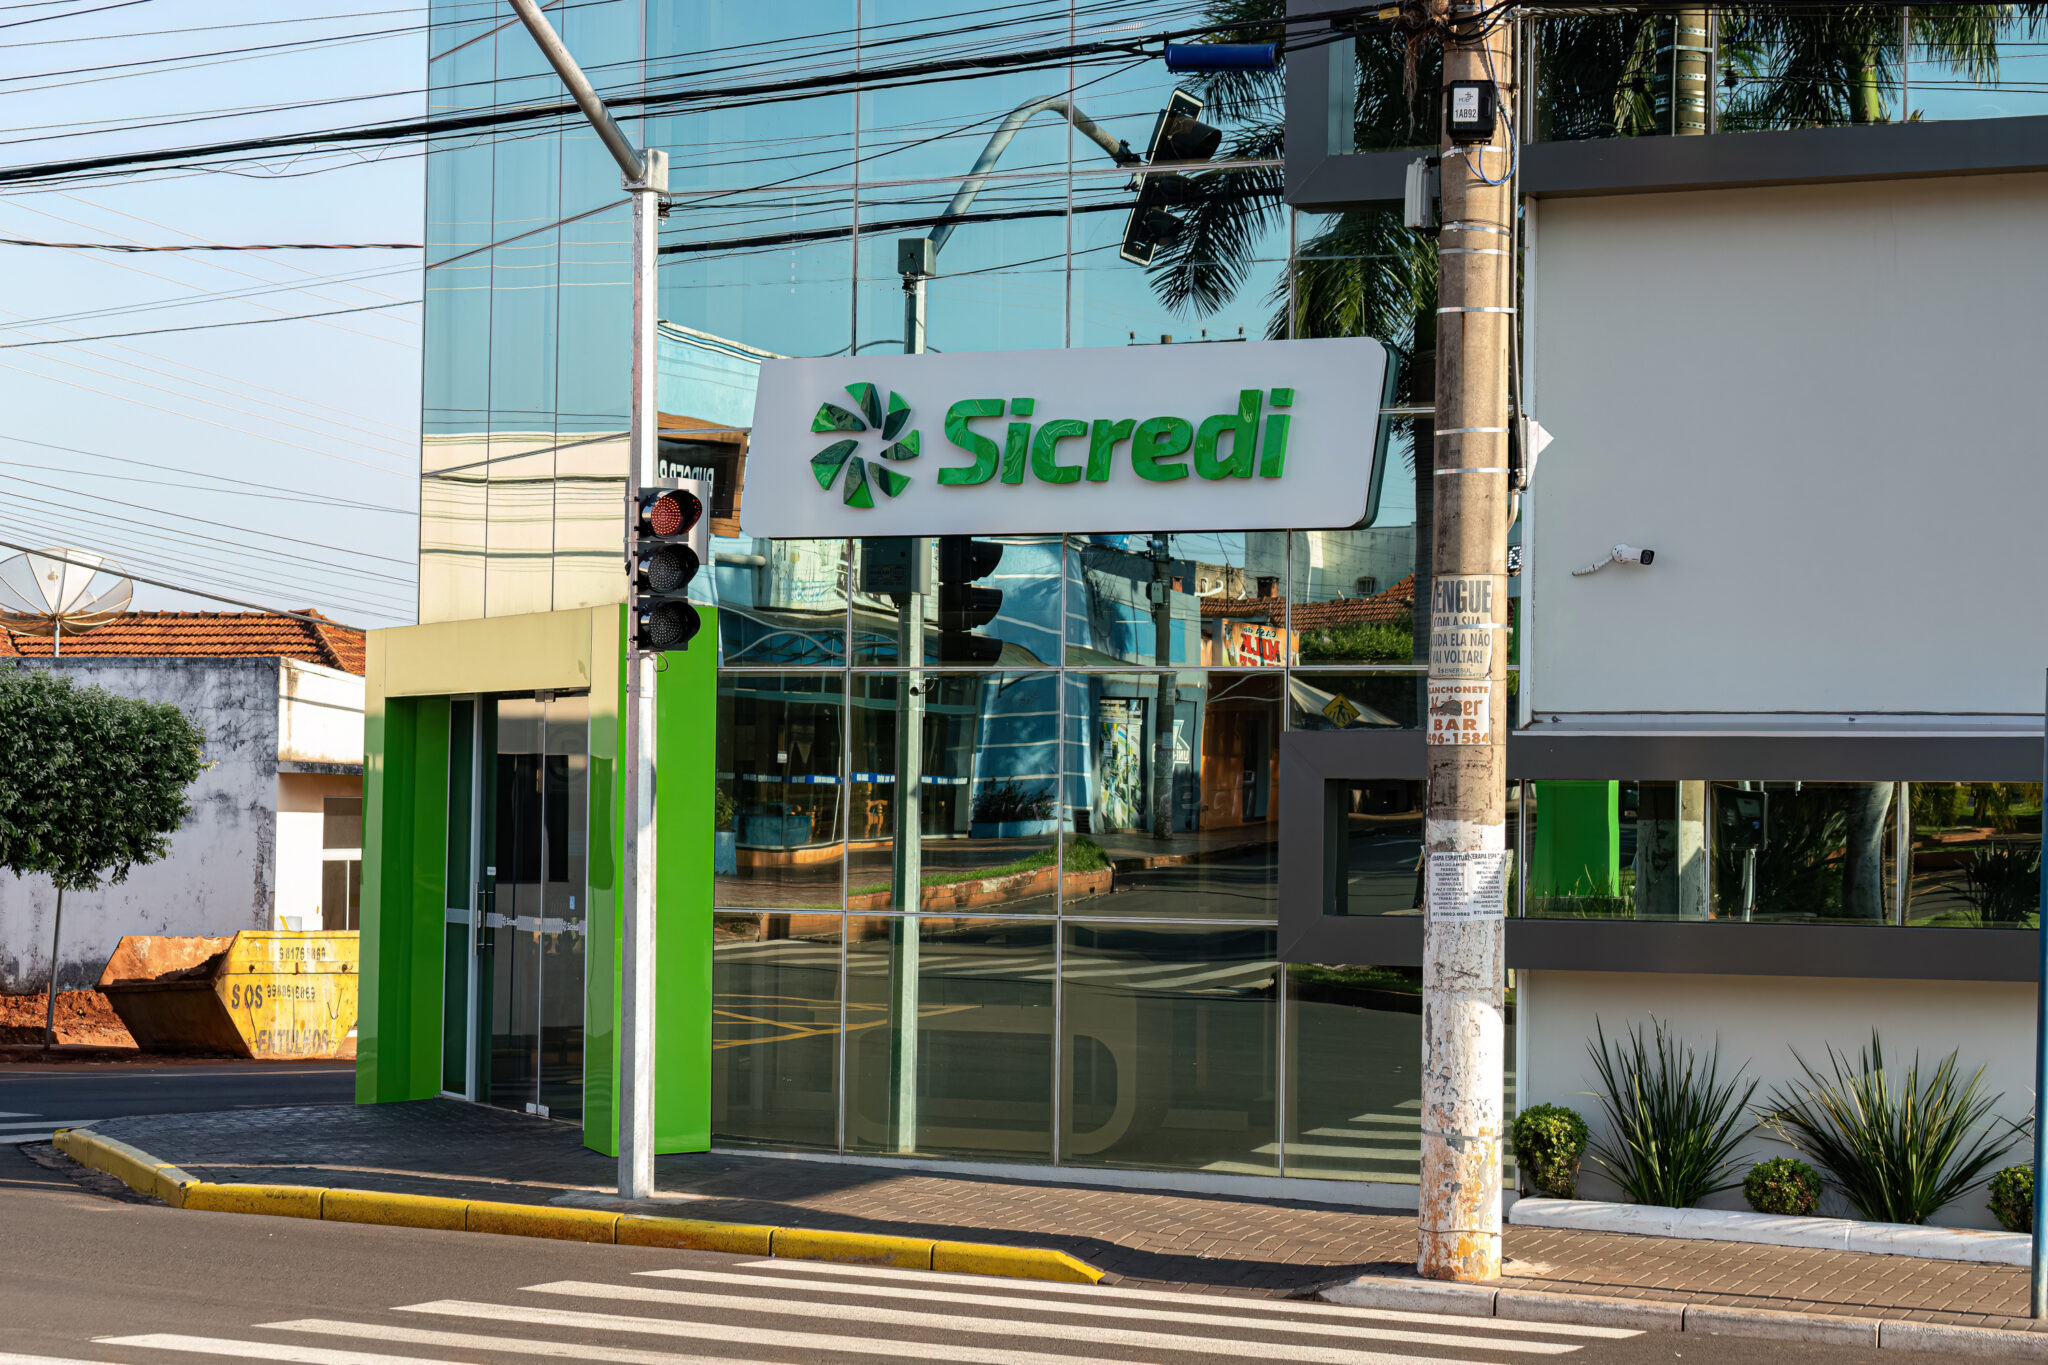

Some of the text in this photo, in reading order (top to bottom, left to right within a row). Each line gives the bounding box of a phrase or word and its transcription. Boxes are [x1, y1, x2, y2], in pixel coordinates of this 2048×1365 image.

[1455, 109, 1477, 118] 1AB92
[937, 387, 1296, 486] Sicredi
[1435, 580, 1491, 613] ENGUE
[1451, 633, 1466, 647] ELA
[1470, 630, 1490, 647] NÃO
[1444, 651, 1483, 664] VOLTAR!
[1434, 719, 1477, 730] BAR
[231, 983, 263, 1009] SOS
[258, 1029, 329, 1054] ENTULHOS
